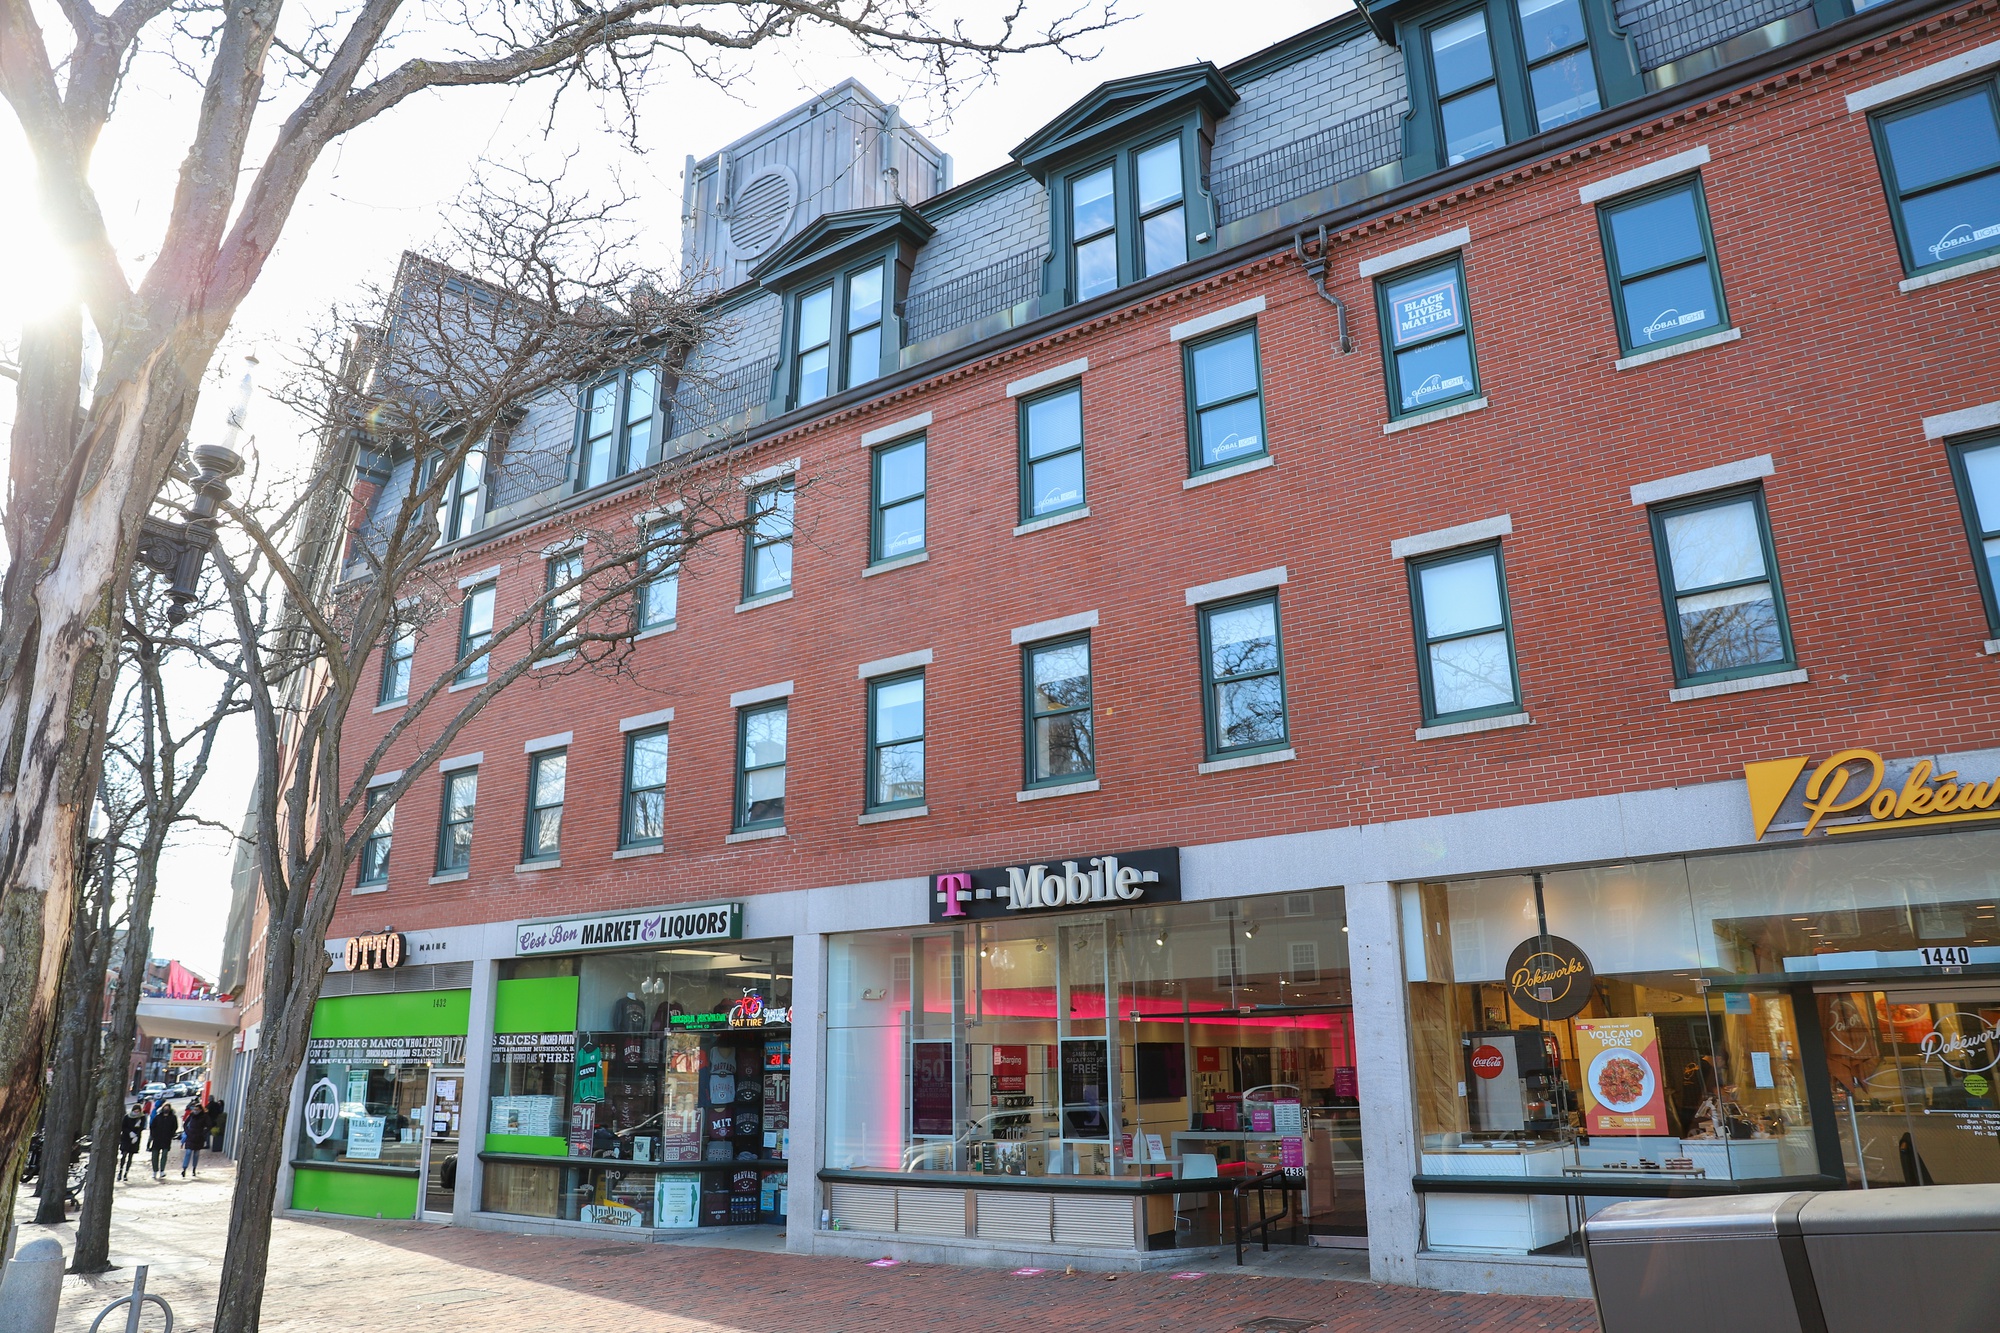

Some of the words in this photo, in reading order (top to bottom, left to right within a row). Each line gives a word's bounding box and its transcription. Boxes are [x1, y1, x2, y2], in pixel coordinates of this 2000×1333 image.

[1928, 235, 1973, 253] GLOBAL
[1976, 226, 2000, 239] LIGH
[1404, 293, 1444, 312] BLACK
[1408, 302, 1443, 320] LIVES
[1402, 309, 1452, 330] MATTER
[1643, 319, 1678, 334] GLOBAL
[1680, 311, 1704, 324] LIGHT
[1412, 384, 1441, 397] GLOBAL
[1442, 376, 1464, 389] LIGHT
[1212, 442, 1237, 453] GLOBAL
[519, 931, 547, 951] C'est
[549, 924, 578, 945] Bon
[581, 919, 641, 945] MARKET
[641, 915, 661, 942] &
[660, 911, 727, 939] LIQUORS
[345, 932, 401, 971] OTTO
[419, 942, 447, 951] MAINE
[1921, 947, 1969, 964] 1440
[1511, 957, 1584, 995] Pokéworks
[433, 999, 447, 1008] 1432
[731, 1019, 745, 1027] FAT
[746, 1018, 763, 1027] TIRE
[499, 1035, 538, 1045] SLICES
[1589, 1029, 1643, 1039] VOLCANO
[336, 1039, 360, 1048] PORK
[361, 1039, 368, 1048] &
[369, 1038, 404, 1048] MANGO
[405, 1038, 427, 1048] WHOLE
[427, 1037, 443, 1047] PIES
[1602, 1038, 1632, 1046] POKE
[178, 1051, 202, 1060] COOP
[411, 1048, 441, 1057] SLICES
[1072, 1064, 1097, 1074] FREE
[309, 1103, 335, 1119] OTTO
[712, 1118, 732, 1130] MIT
[606, 1170, 621, 1180] UFO
